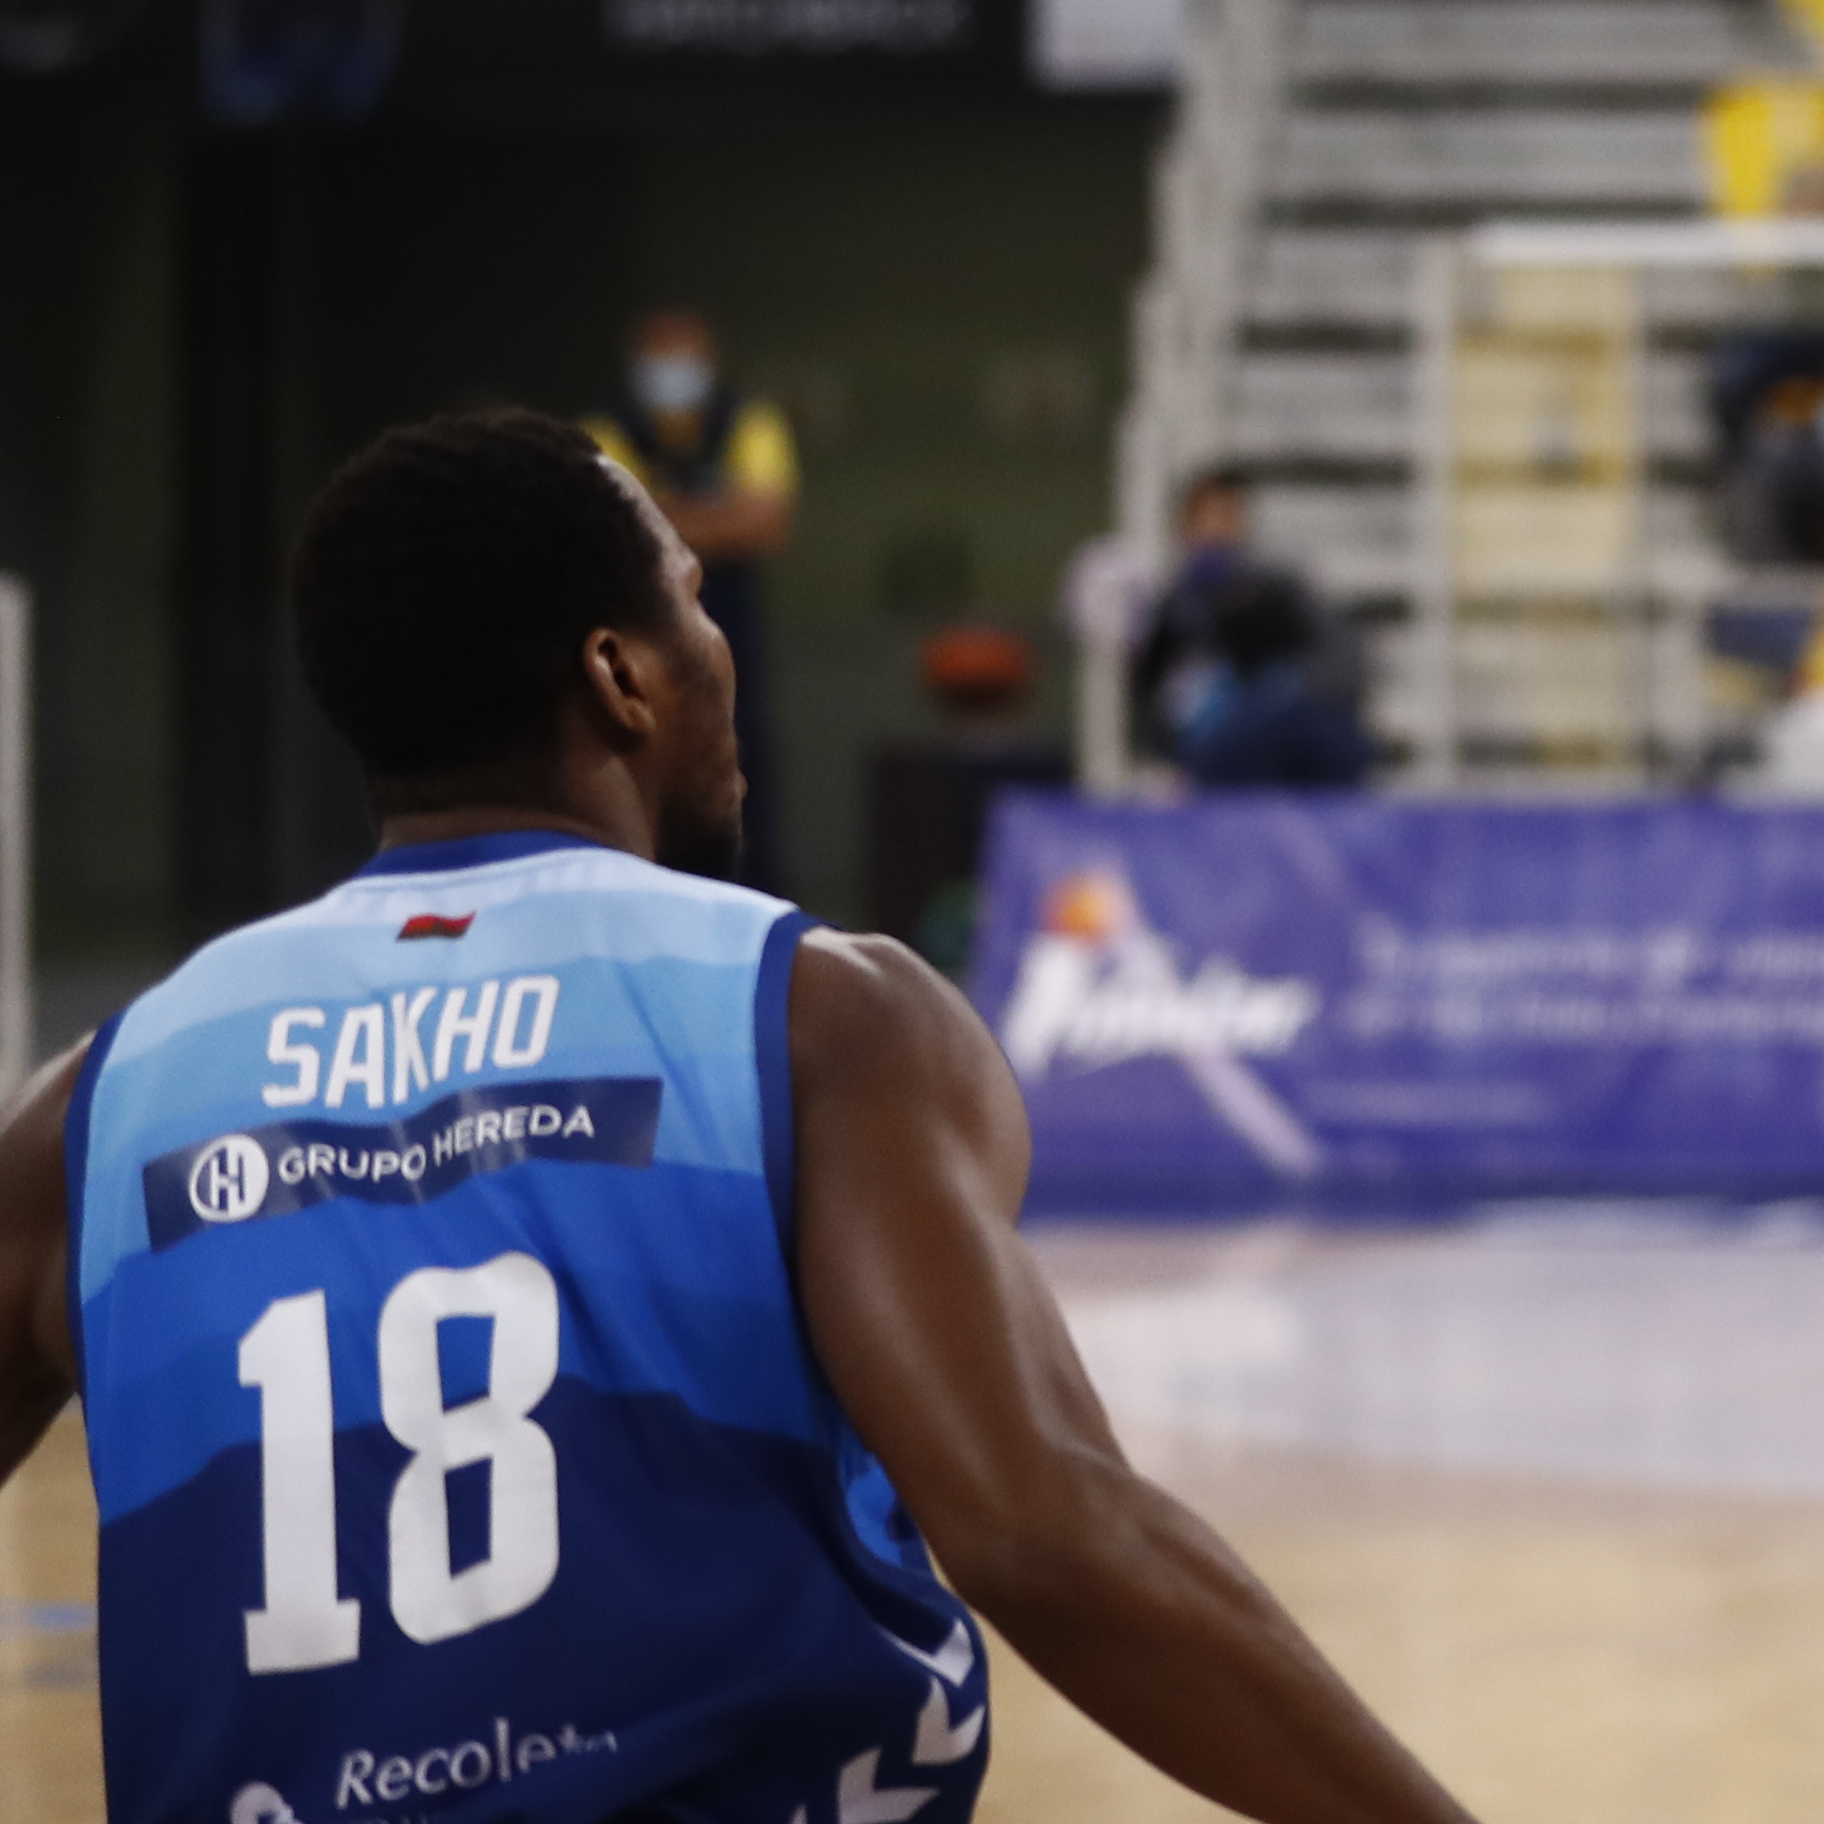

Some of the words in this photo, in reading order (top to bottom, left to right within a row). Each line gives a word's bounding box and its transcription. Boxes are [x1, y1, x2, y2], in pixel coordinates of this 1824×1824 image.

[261, 974, 561, 1110] SAKHO
[278, 1142, 427, 1185] GRUPO
[433, 1105, 597, 1167] HEREDA
[237, 1252, 559, 1676] 18
